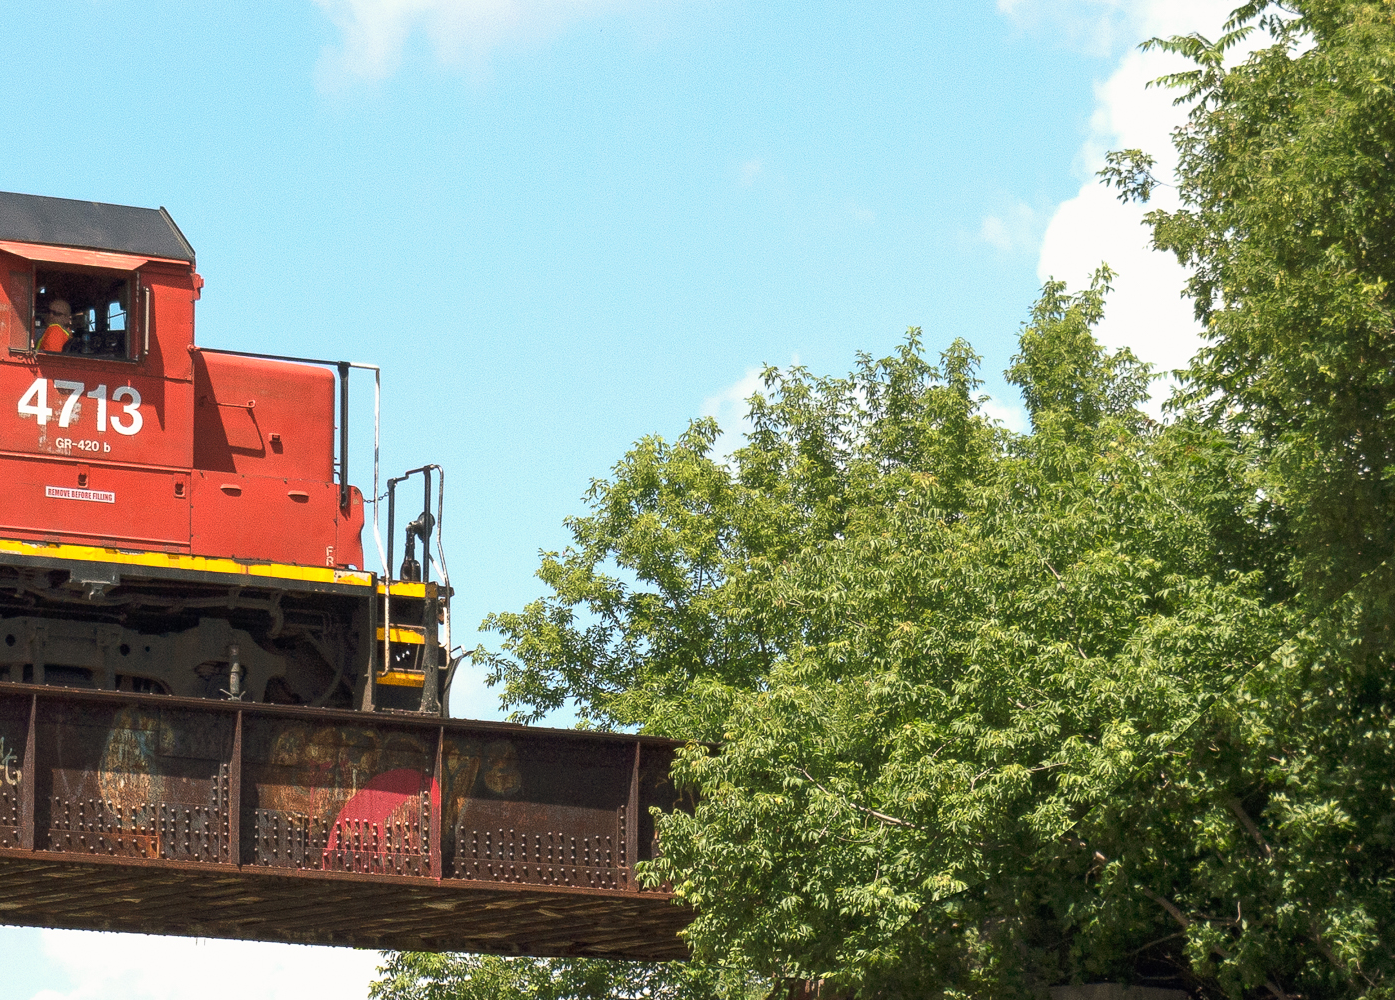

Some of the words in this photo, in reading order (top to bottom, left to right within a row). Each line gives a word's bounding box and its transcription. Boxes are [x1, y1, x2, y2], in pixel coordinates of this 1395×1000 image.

[18, 378, 143, 436] 4713
[55, 437, 100, 452] GR-420
[103, 442, 111, 453] b
[47, 488, 70, 498] REMOVE
[71, 490, 92, 500] BEFORE
[93, 492, 113, 502] FILLING
